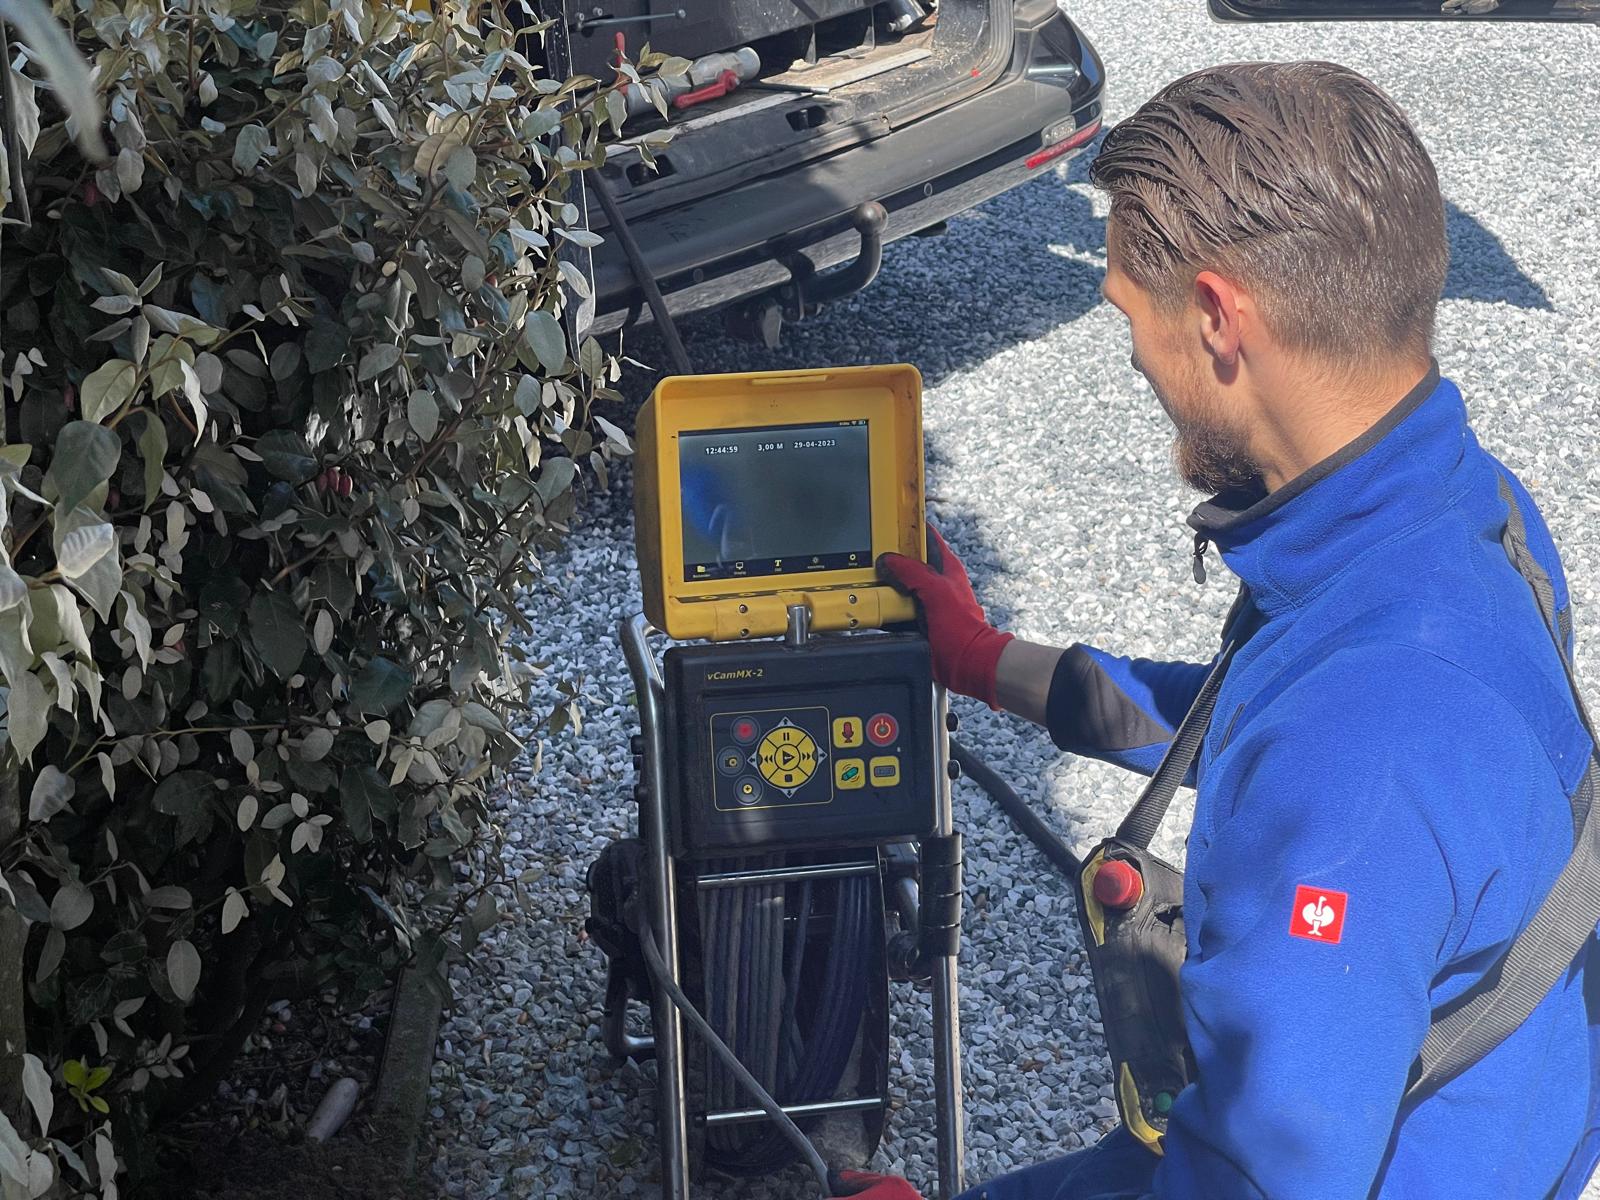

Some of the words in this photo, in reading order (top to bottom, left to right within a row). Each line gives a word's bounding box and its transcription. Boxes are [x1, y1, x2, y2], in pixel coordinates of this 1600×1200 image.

[757, 443, 775, 452] 3,00
[794, 439, 836, 449] 29-04-2023
[705, 446, 738, 455] 12:44:59
[707, 668, 764, 680] vCamMX-2
